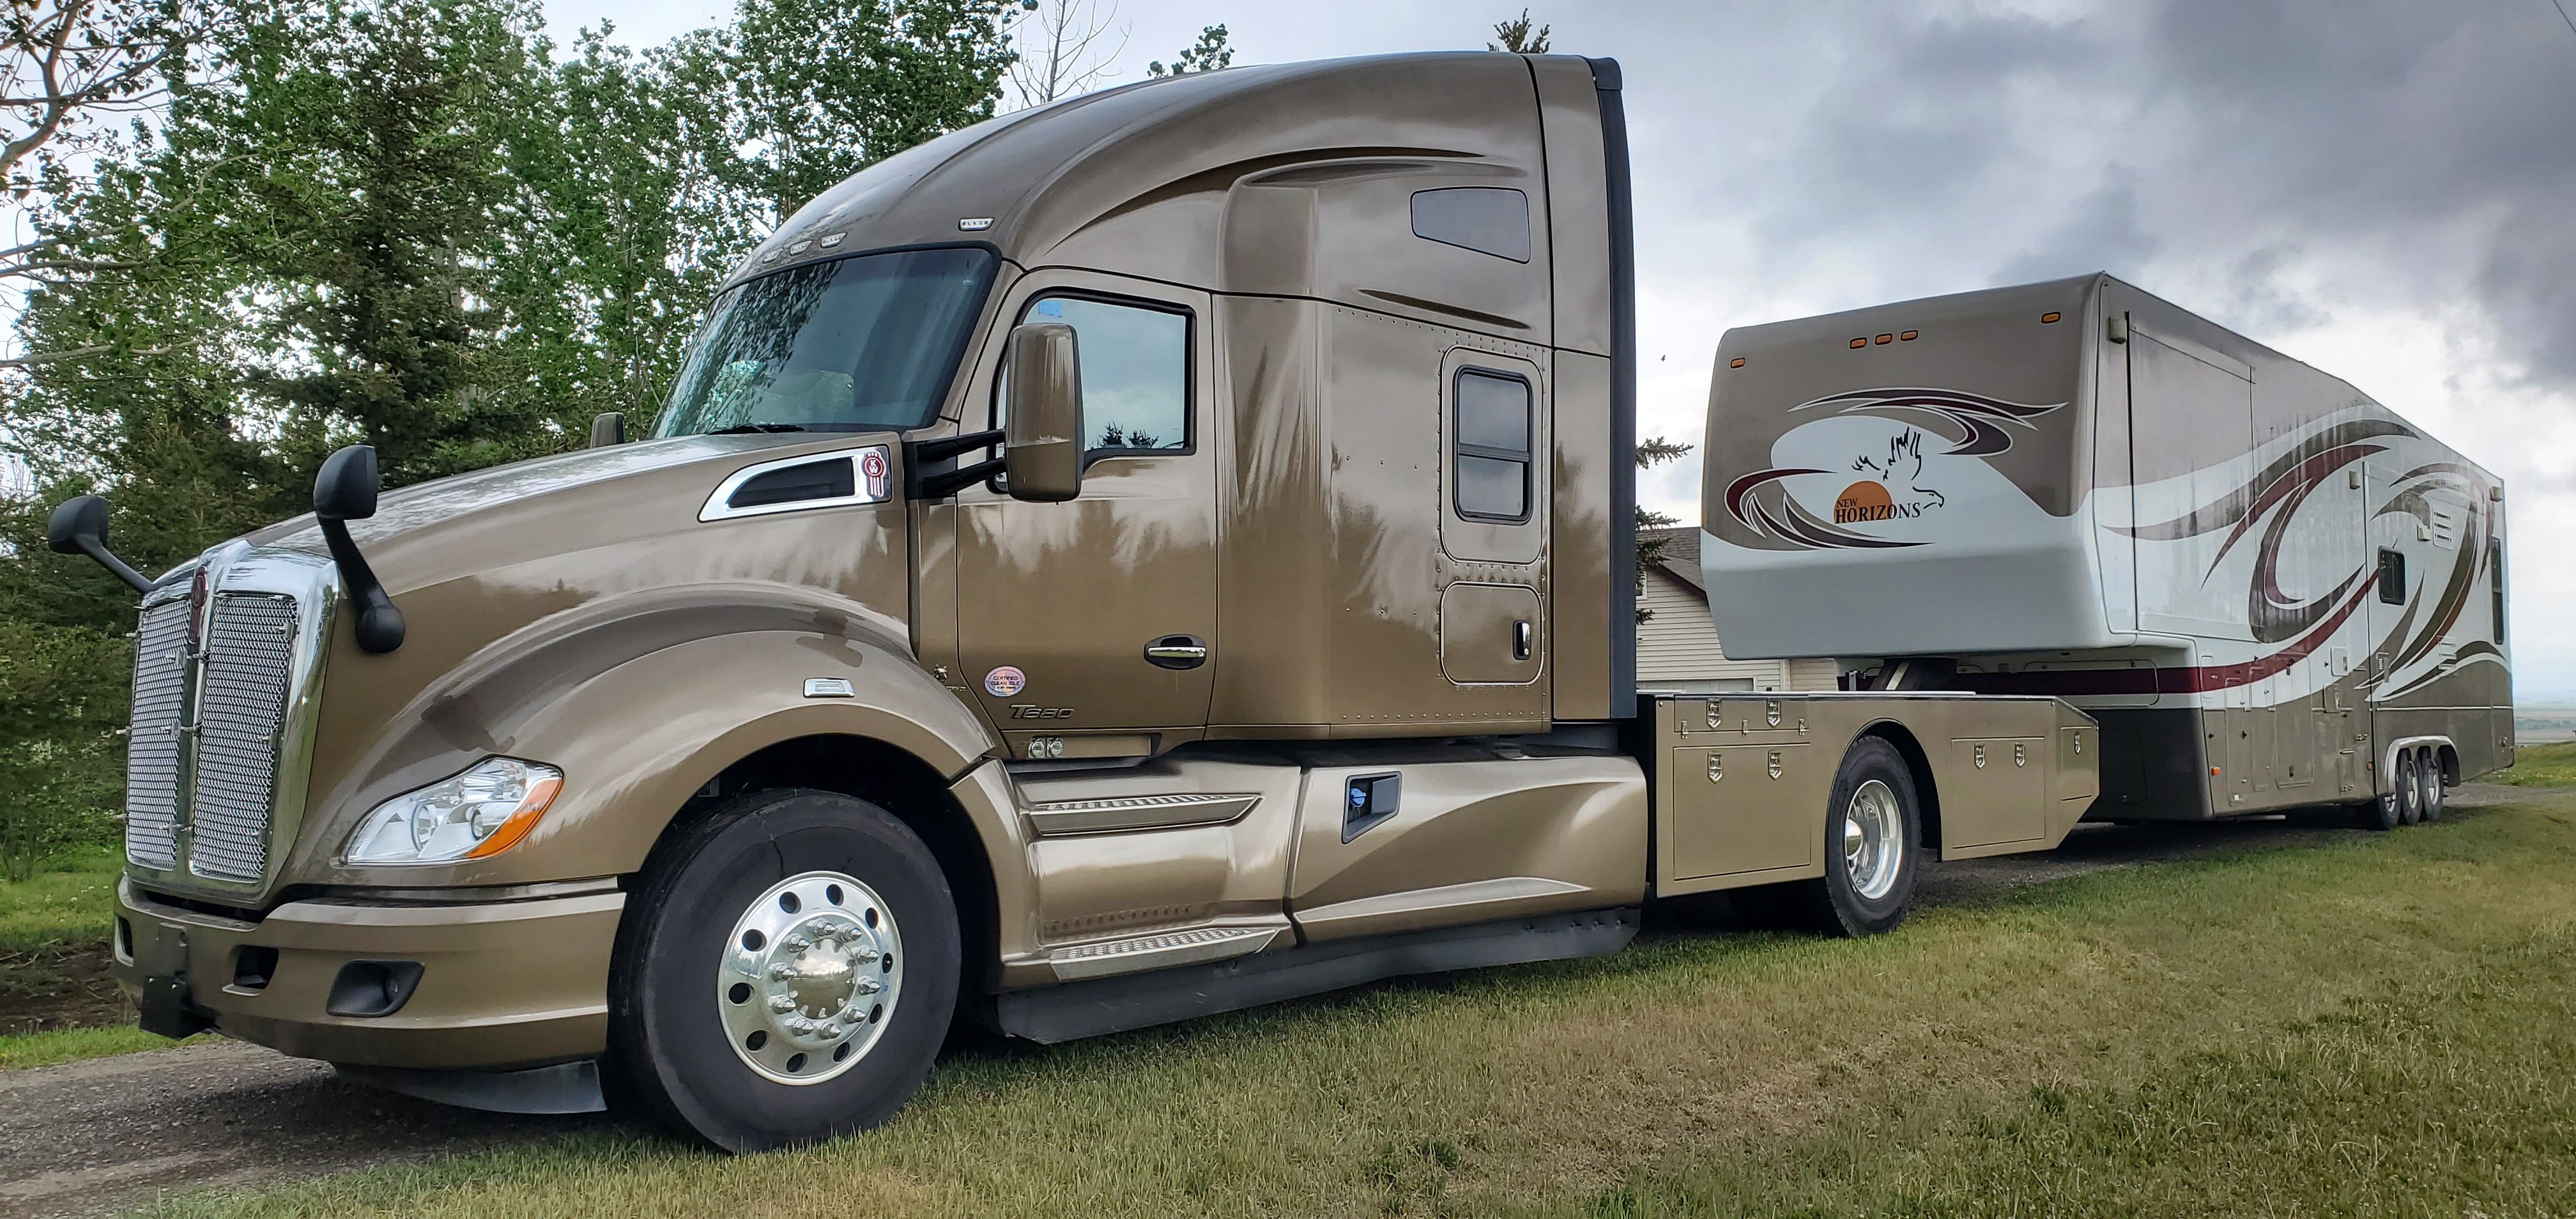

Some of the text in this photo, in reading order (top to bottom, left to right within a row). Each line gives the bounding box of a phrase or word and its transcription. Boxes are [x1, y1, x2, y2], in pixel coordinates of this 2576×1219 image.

[1836, 498, 1858, 508] NEW
[1835, 502, 1920, 524] HORIZONS
[1010, 704, 1076, 719] T680
